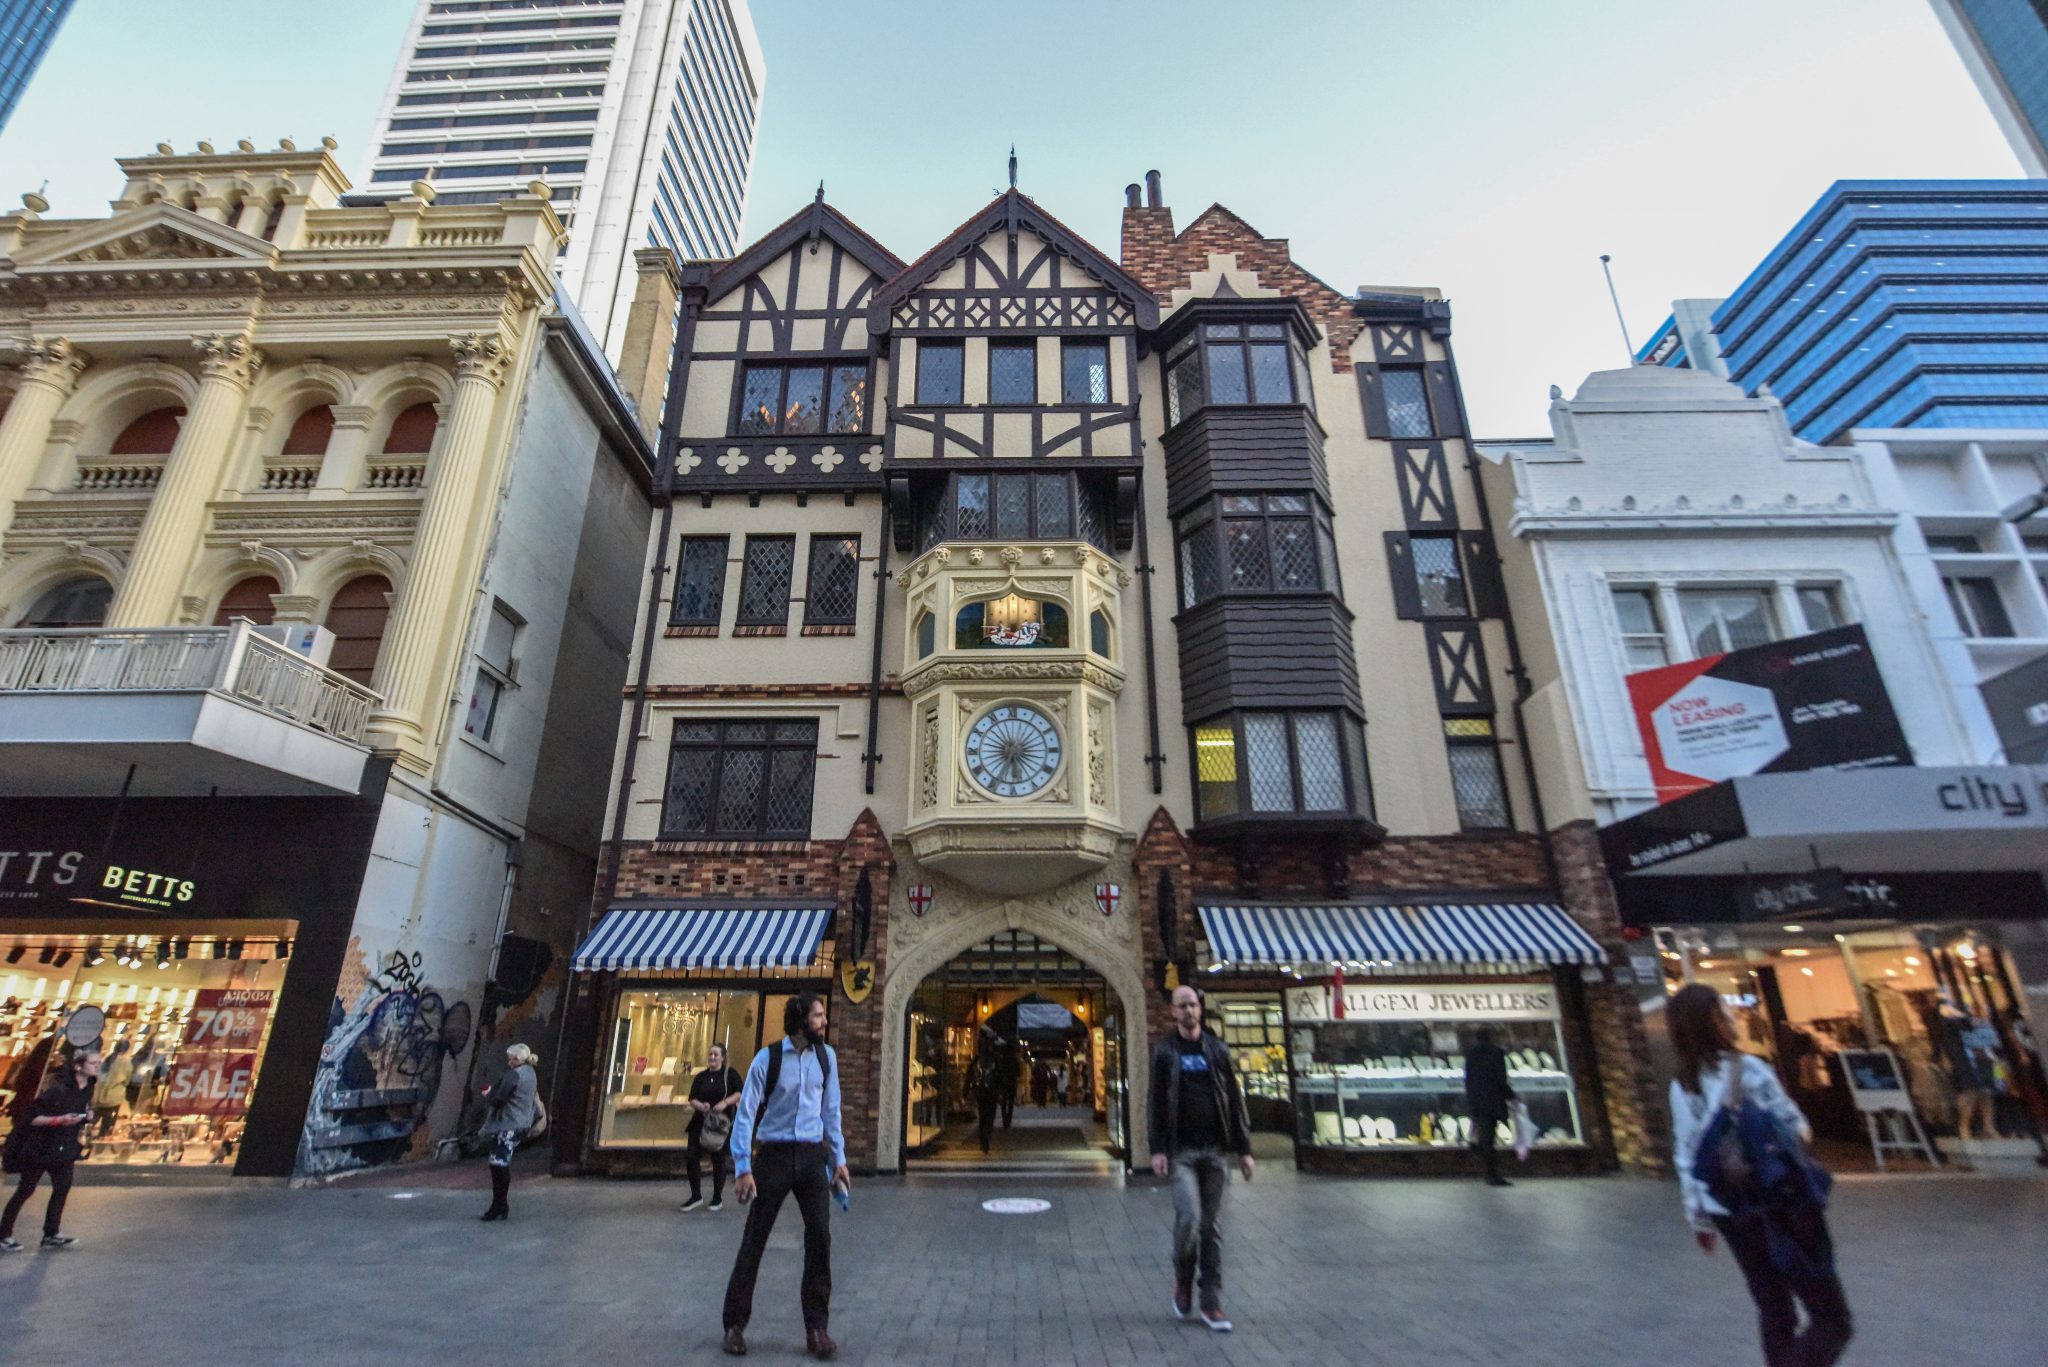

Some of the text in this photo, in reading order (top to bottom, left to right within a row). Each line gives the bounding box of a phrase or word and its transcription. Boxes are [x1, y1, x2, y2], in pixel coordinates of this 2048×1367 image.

[1669, 697, 1709, 714] NOW
[1671, 702, 1746, 727] LEASING
[1937, 775, 2028, 818] city
[0, 851, 84, 885] TTS
[102, 866, 195, 902] BETTS
[1428, 992, 1550, 1012] JEWELLERS
[192, 1009, 256, 1041] 70%
[170, 1067, 250, 1100] SALE
